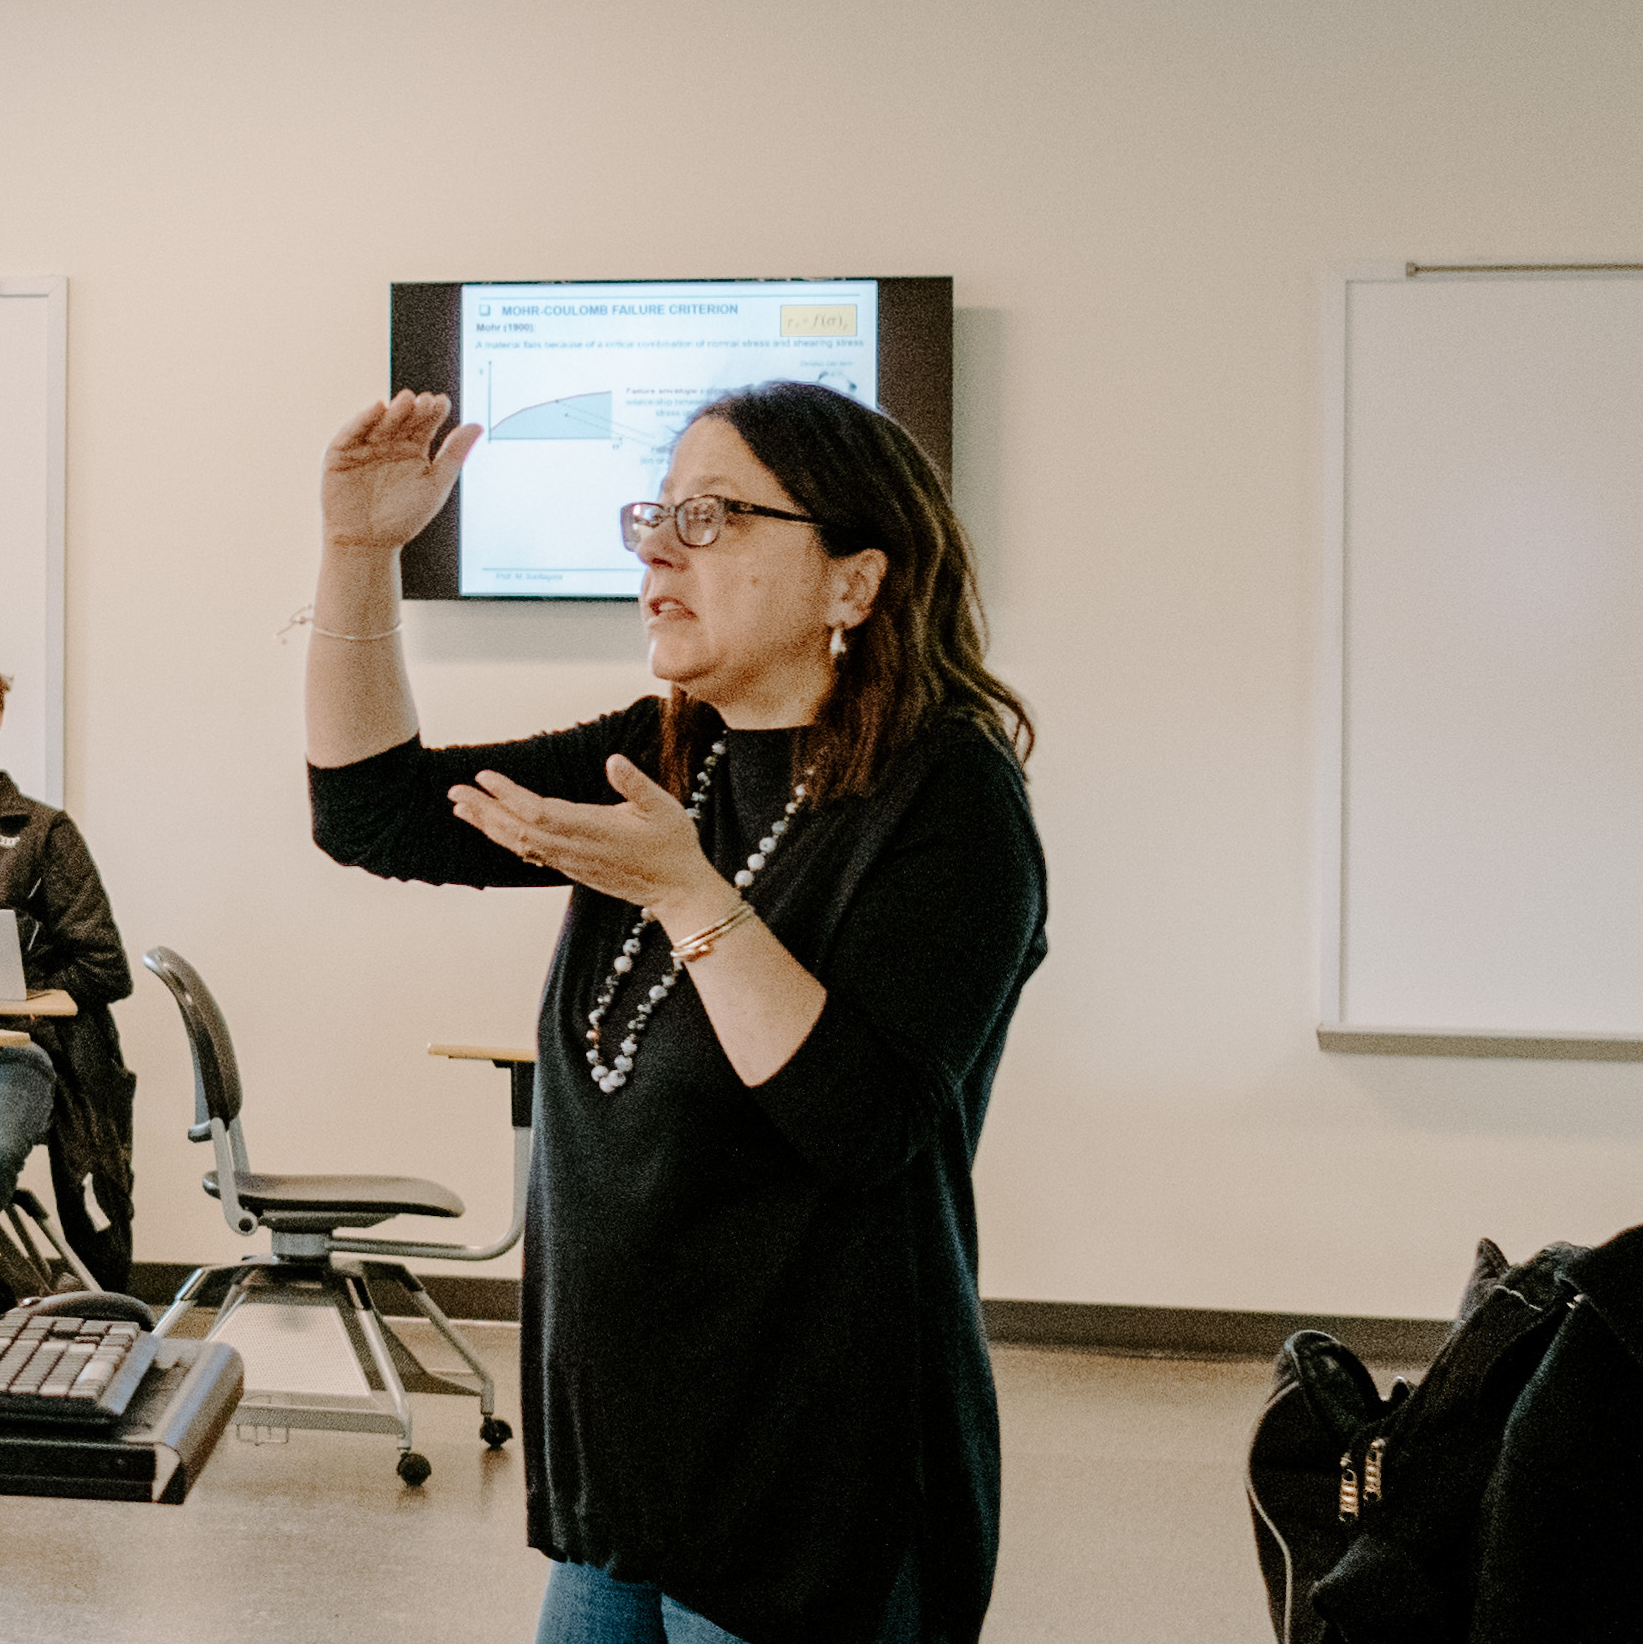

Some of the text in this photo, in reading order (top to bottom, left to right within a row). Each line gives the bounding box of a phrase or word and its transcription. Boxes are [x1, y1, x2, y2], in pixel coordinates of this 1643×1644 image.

[502, 303, 739, 317] MOHR-COULOMB FAILURE CRITERION
[476, 322, 501, 332] Mohr
[545, 340, 583, 349] because
[585, 340, 595, 348] of
[637, 339, 694, 348] combination
[696, 339, 706, 348] of
[707, 339, 740, 348] normal
[742, 340, 771, 348] stress
[773, 338, 791, 347] and
[793, 338, 833, 349] shearing
[836, 338, 865, 347] stress
